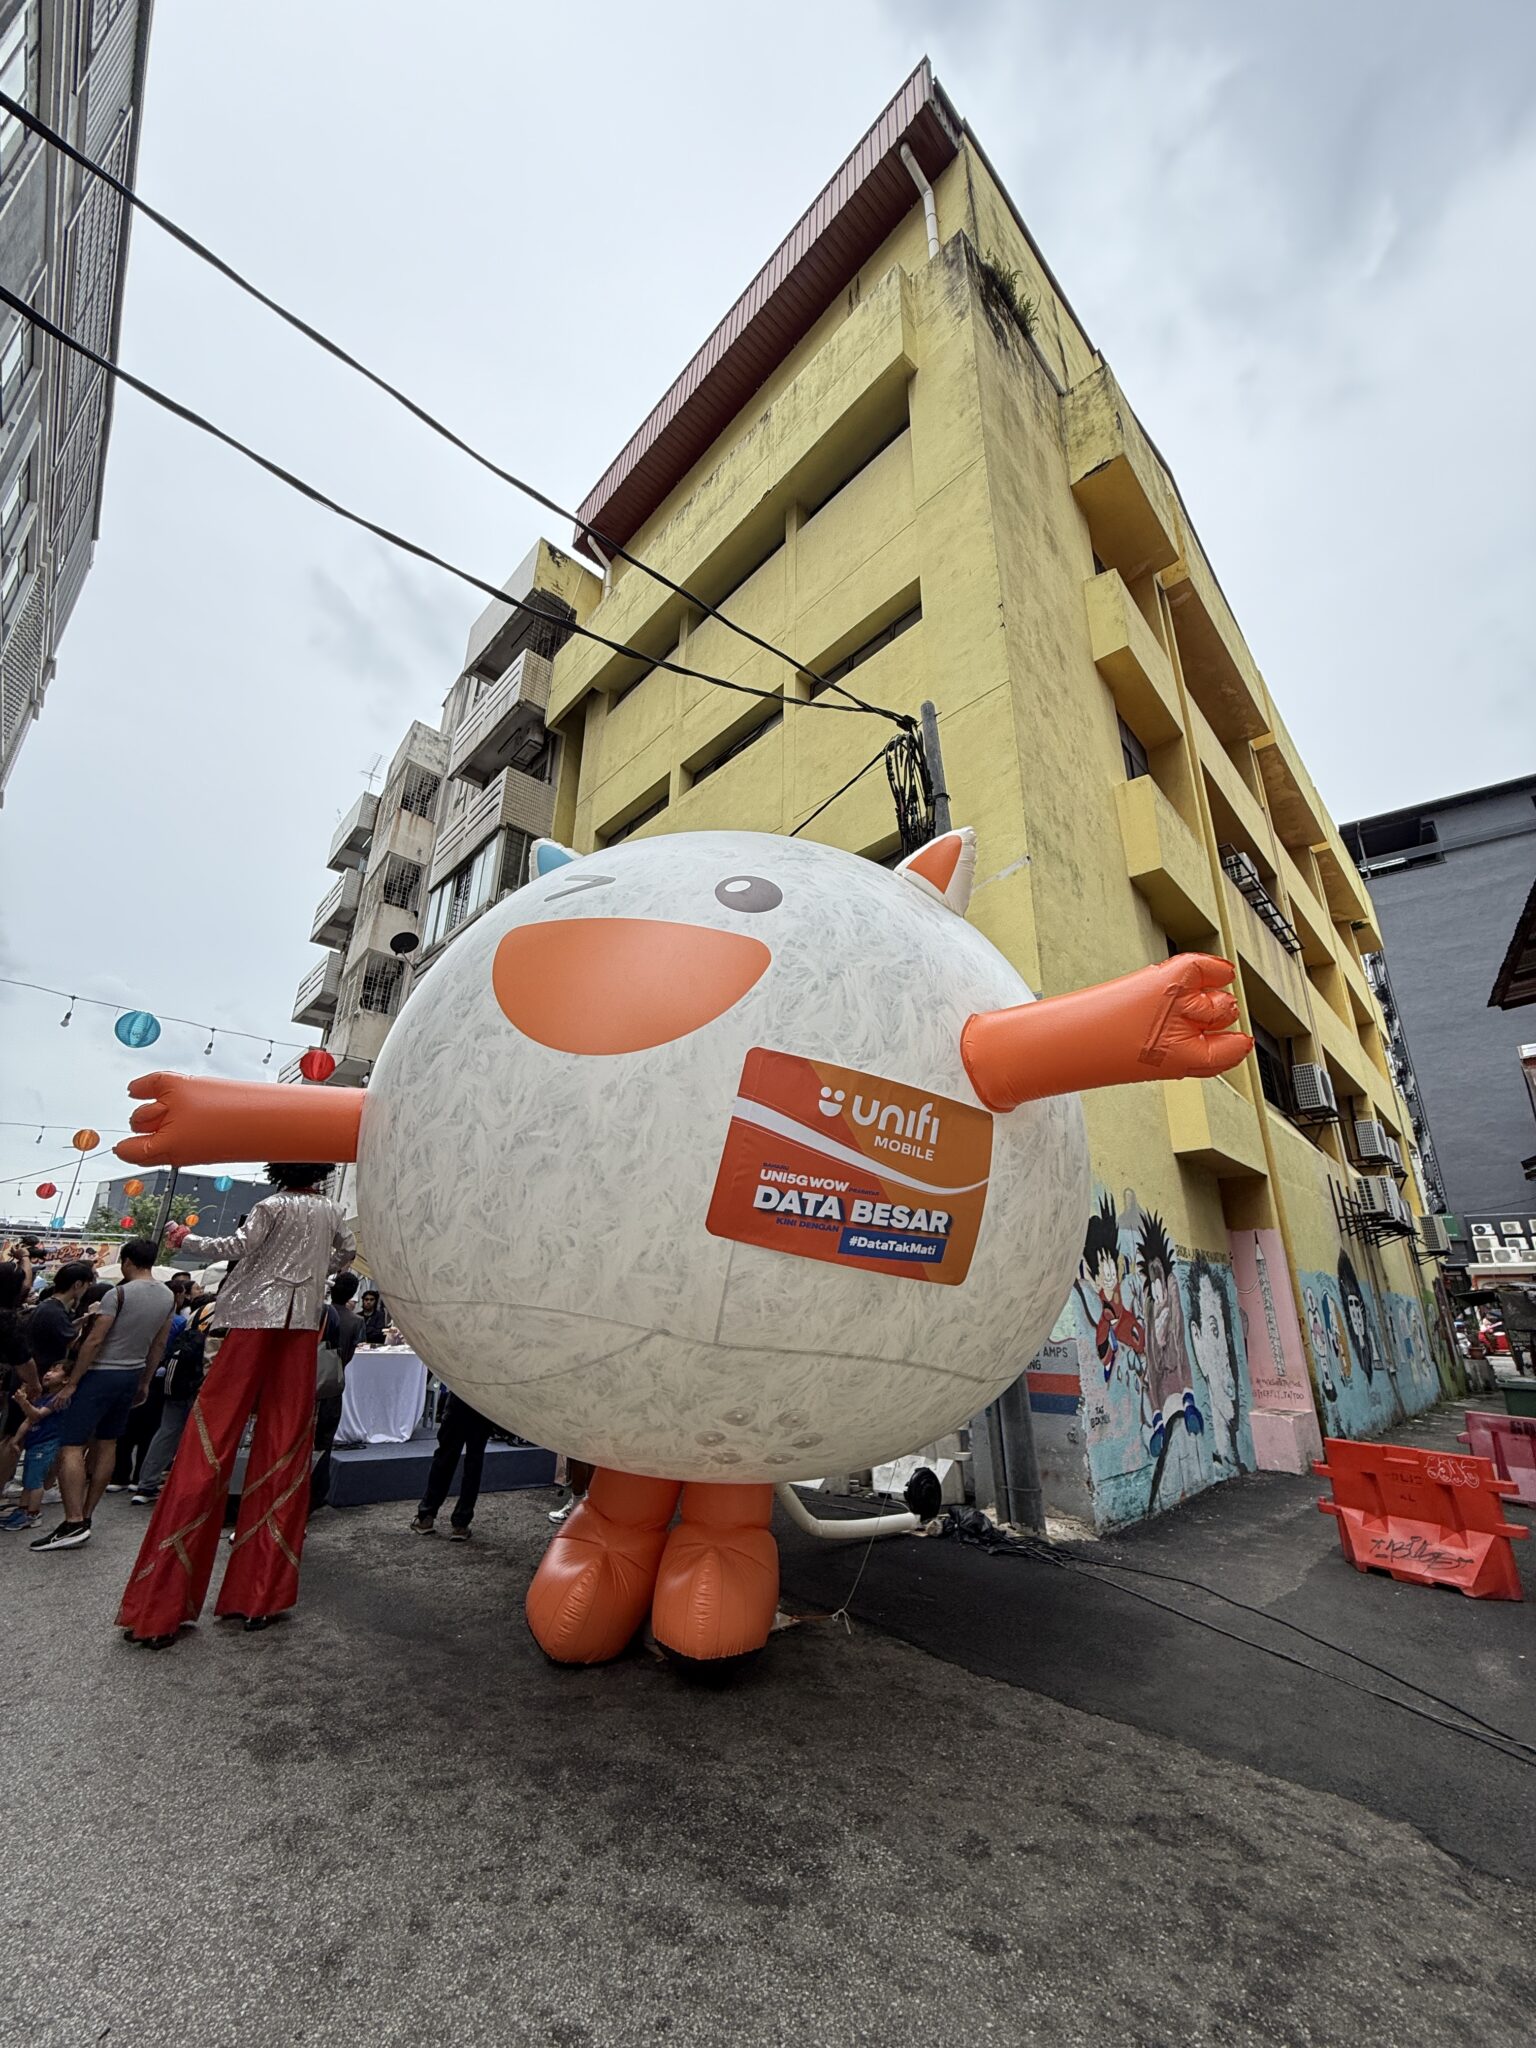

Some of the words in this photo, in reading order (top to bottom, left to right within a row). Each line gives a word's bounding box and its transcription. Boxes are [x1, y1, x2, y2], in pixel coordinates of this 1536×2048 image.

[852, 1095, 939, 1144] unifi
[873, 1135, 935, 1161] MOBILE
[753, 1184, 844, 1220] DATA
[850, 1199, 950, 1234] BESAR
[775, 1217, 798, 1228] KINI
[798, 1220, 839, 1232] DENGAN
[849, 1236, 936, 1255] #DataTakMati
[1043, 1346, 1069, 1358] AMPS
